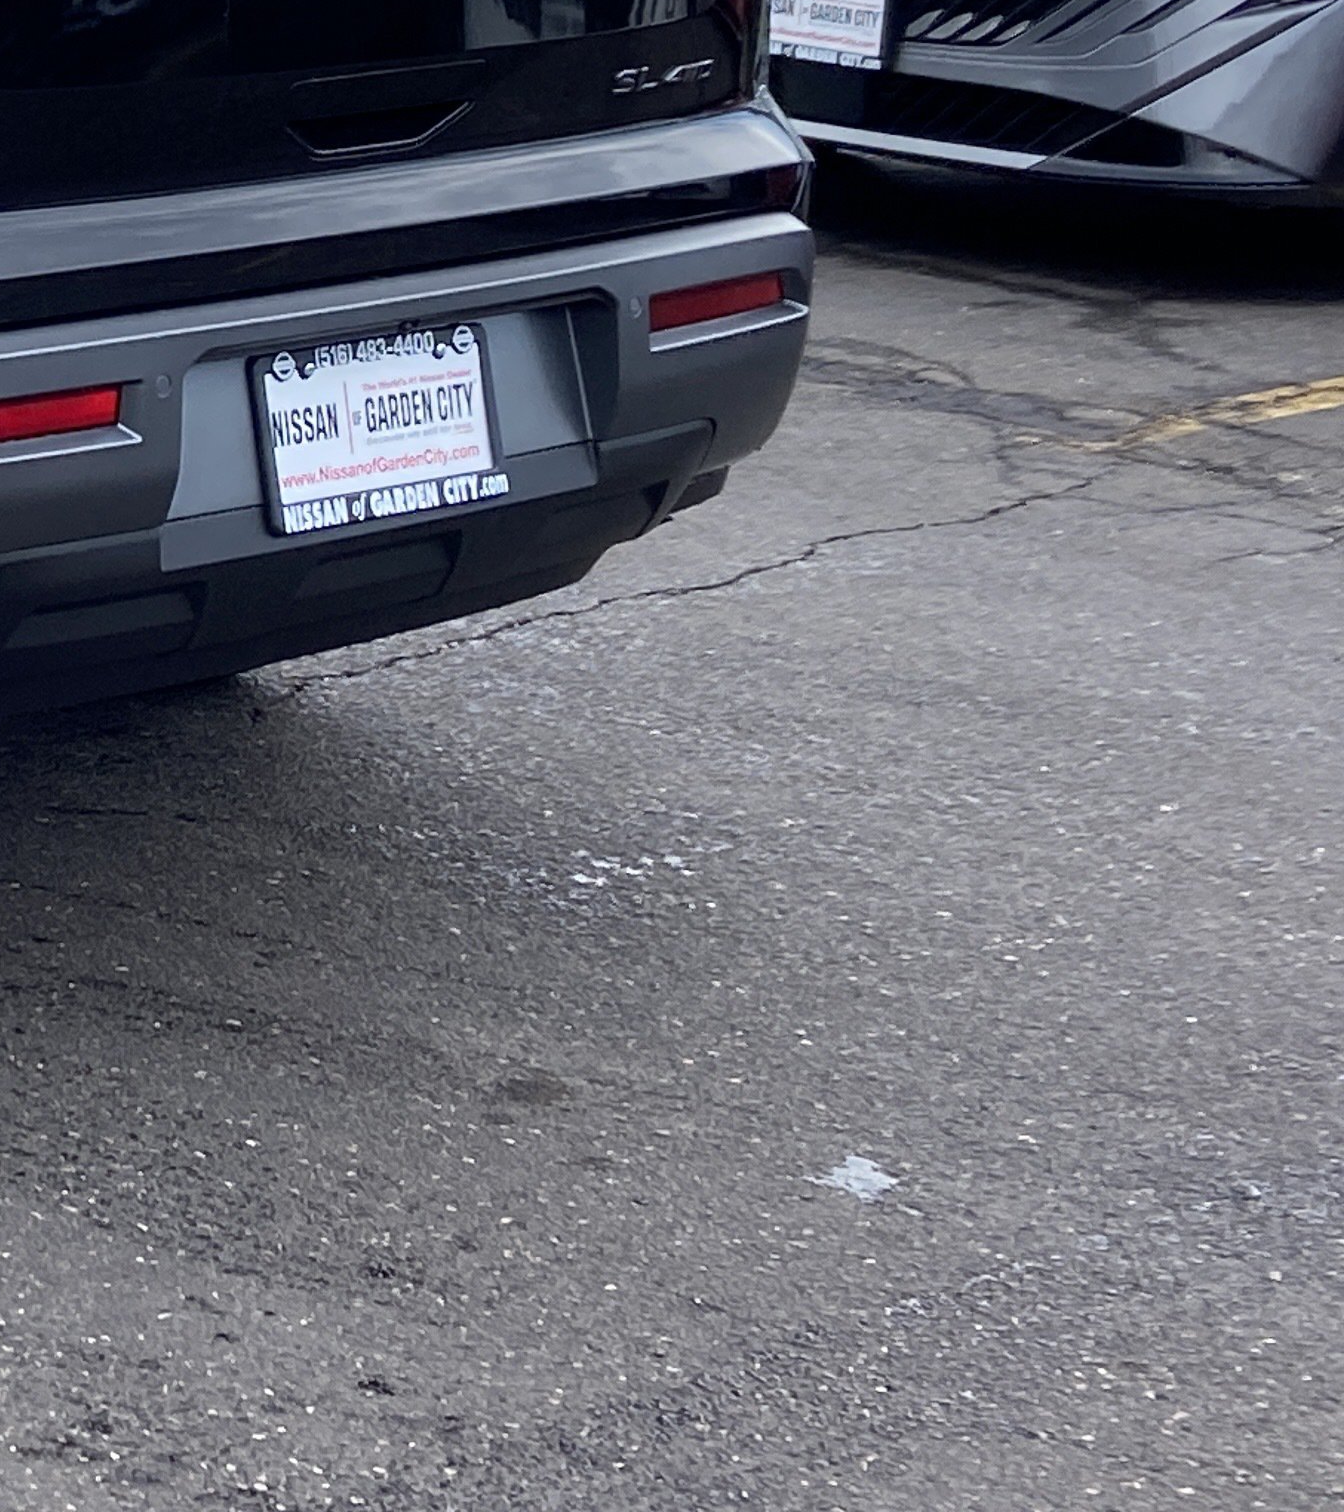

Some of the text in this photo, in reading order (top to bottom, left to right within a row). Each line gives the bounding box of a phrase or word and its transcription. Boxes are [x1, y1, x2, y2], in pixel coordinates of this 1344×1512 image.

[810, 2, 853, 25] GARDEN
[853, 8, 881, 29] CITY
[314, 330, 435, 369] (516) 483-4400
[272, 402, 340, 448] NISSAN
[365, 388, 433, 433] GARDEN
[436, 381, 473, 421] CITY
[281, 443, 480, 489] www.NissanofGardenCity.com
[283, 495, 349, 534] NISSAN
[351, 492, 367, 522] of
[369, 481, 441, 518] GARDEN
